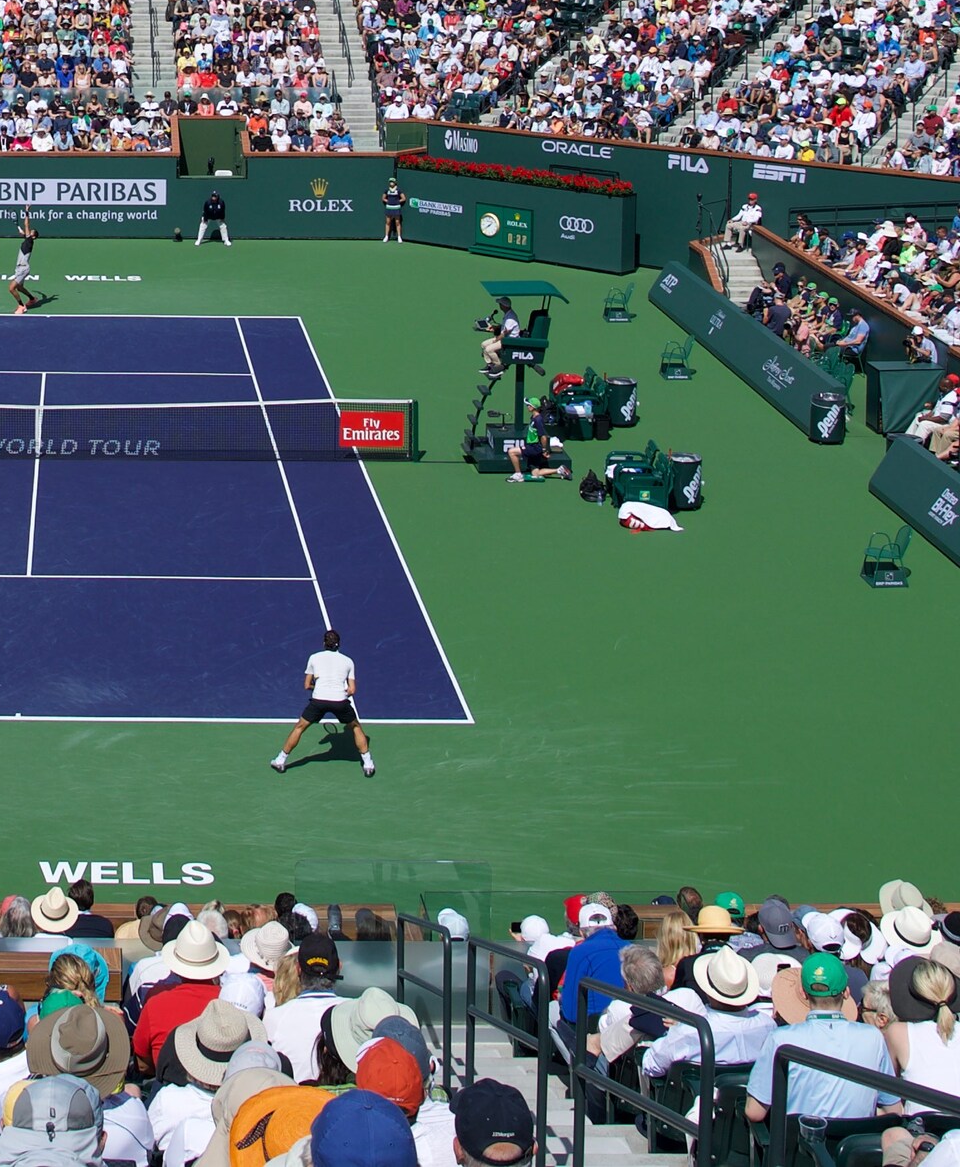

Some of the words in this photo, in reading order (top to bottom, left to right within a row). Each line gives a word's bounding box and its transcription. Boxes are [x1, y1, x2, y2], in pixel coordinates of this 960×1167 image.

[541, 140, 612, 159] ORACLE
[668, 154, 709, 174] FILA
[752, 163, 806, 184] ESPN
[56, 182, 157, 202] PARIBAS
[288, 199, 354, 212] ROLEX
[47, 209, 64, 222] for
[67, 212, 73, 220] a
[77, 210, 124, 222] changing
[127, 210, 158, 220] world
[506, 220, 528, 229] ROLEX
[512, 352, 534, 360] FILA
[363, 418, 380, 428] Fly
[343, 427, 400, 440] Emirates
[89, 439, 161, 456] TOUR
[503, 439, 525, 452] FIL
[39, 861, 215, 885] WELLS
